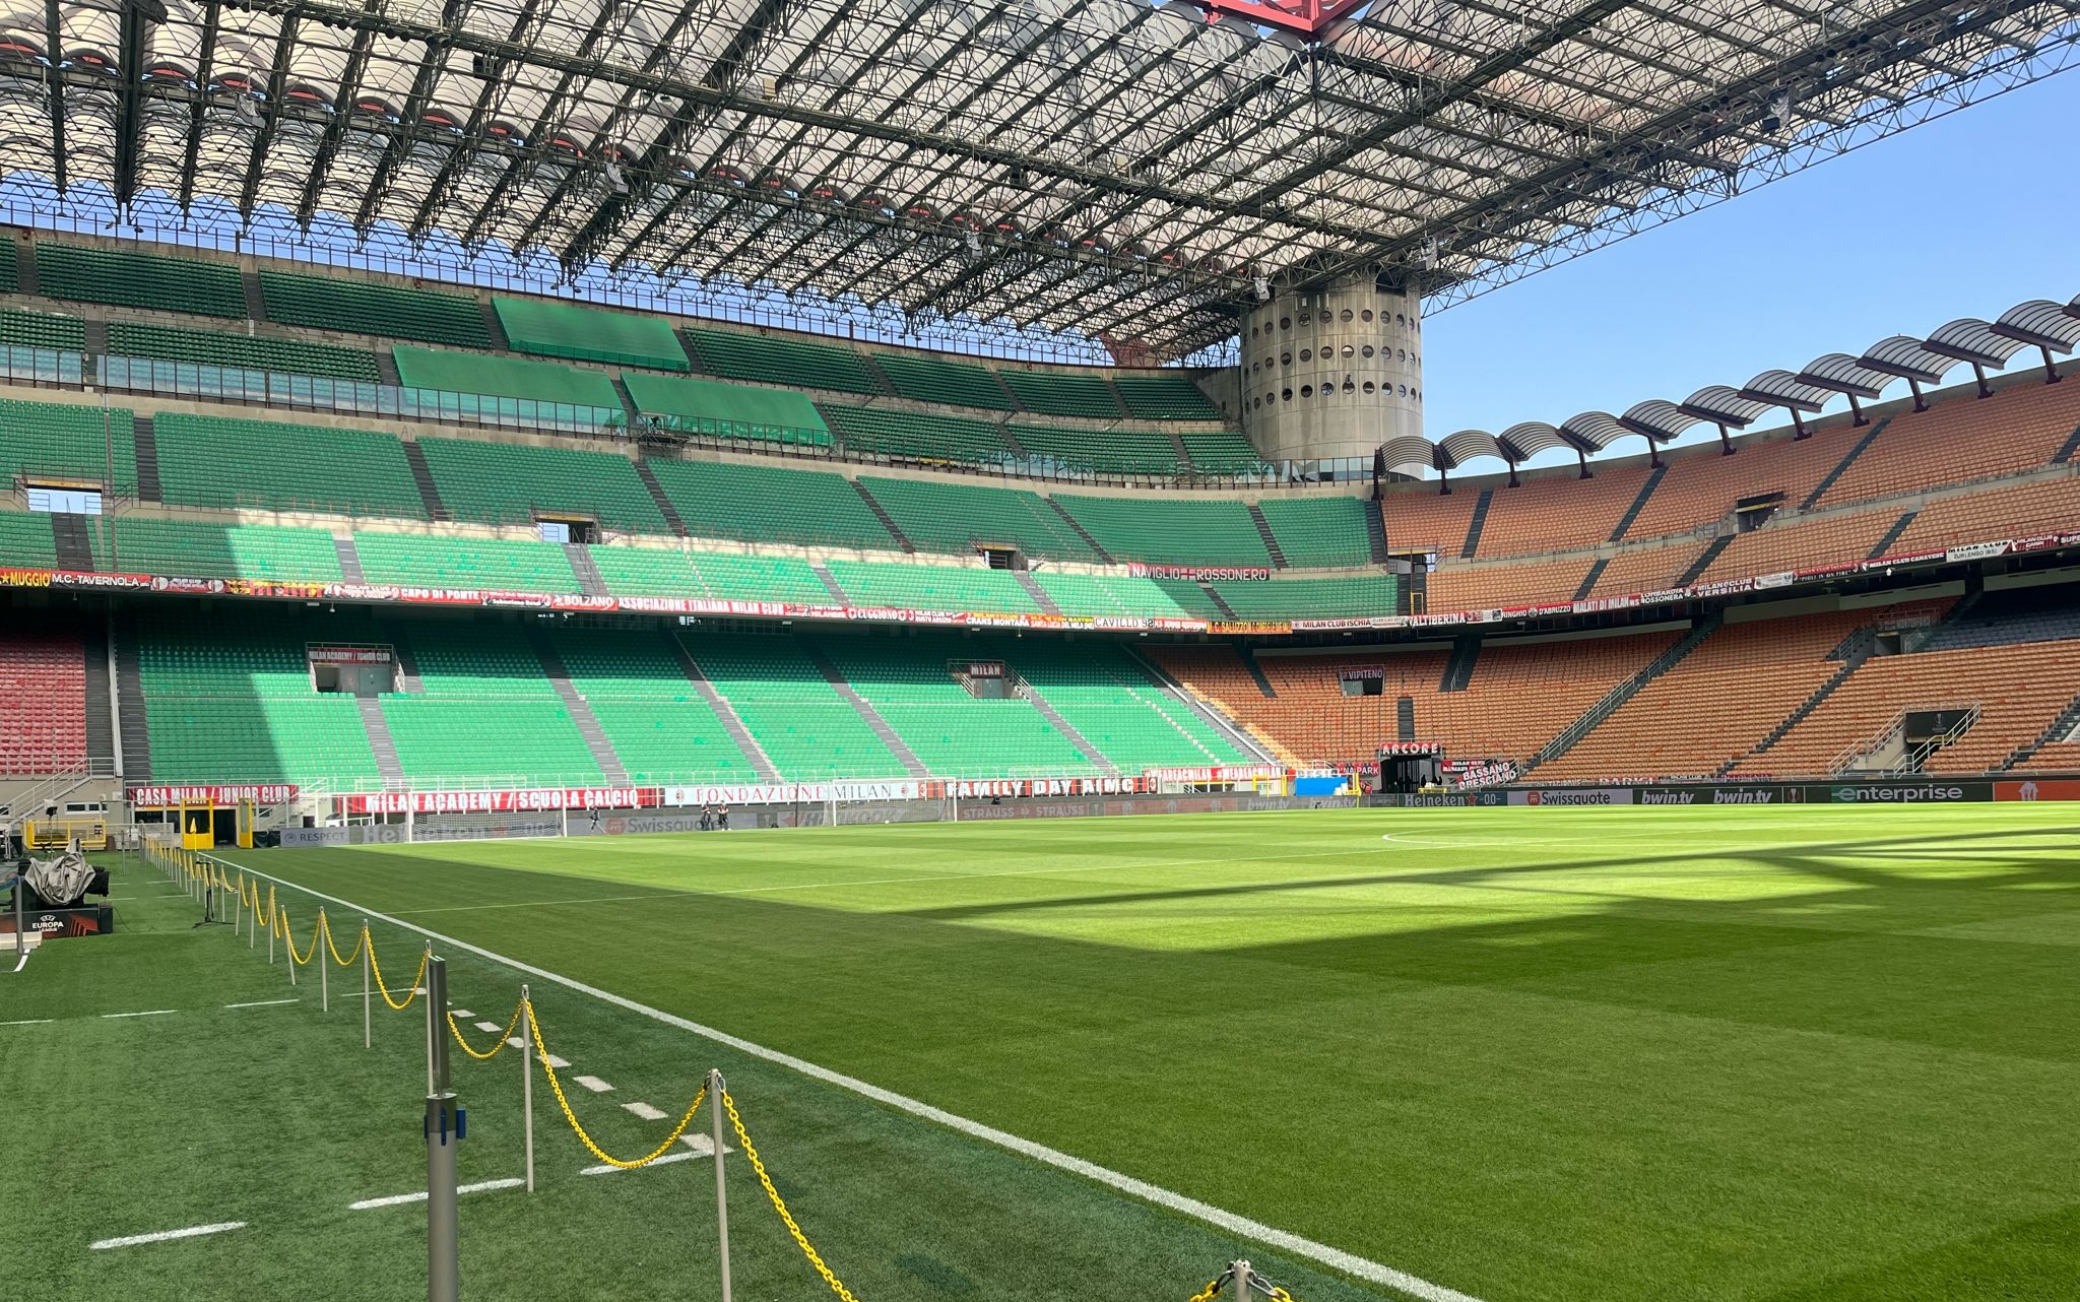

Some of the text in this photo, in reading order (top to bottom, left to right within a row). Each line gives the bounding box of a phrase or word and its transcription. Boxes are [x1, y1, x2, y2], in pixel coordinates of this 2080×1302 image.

[1870, 560, 1892, 568] MILAN
[1892, 558, 1910, 566] CLUB
[1132, 567, 1267, 581] NAVIGLIO ROSSONERO
[1697, 582, 1725, 592] MILAN
[1728, 577, 1752, 588] CLUB
[1697, 584, 1752, 598] VERSILIA
[401, 588, 428, 598] CAPO
[433, 589, 443, 598] DI
[446, 590, 479, 600] PONTE
[1641, 587, 1683, 597] LOMBARDIA
[1641, 593, 1684, 604] ROSSONERA
[564, 595, 613, 606] BOLZANO
[619, 597, 688, 612] ASSOCIAZIONE
[689, 599, 730, 613] ITALIANA
[731, 601, 759, 614] MILAN
[762, 603, 784, 616] CLUB
[1573, 600, 1598, 613] MALATI
[1599, 599, 1607, 611] DI
[1608, 596, 1629, 610] MILAN
[857, 608, 898, 619] CUGGIONO
[1409, 612, 1466, 628] VALTIBERINA
[993, 618, 1030, 627] MONTANA
[1302, 620, 1326, 628] MILAN
[1327, 619, 1346, 627] CLUB
[1347, 618, 1371, 627] ISCHIA
[376, 652, 391, 661] CLUB
[971, 665, 1000, 675] MILAN
[1348, 669, 1383, 680] VIPITENO
[1382, 743, 1439, 756] ARCORE
[1357, 766, 1379, 775] PARK
[1463, 762, 1510, 781] BASSANO
[696, 782, 892, 802] FONDAZIONE MILAN
[946, 777, 1134, 797] FAMILY DAY AIMC
[1833, 784, 1963, 803] enterprise
[136, 787, 168, 805] CASA
[171, 787, 207, 804] MILAN
[218, 786, 258, 804] JUNIOR
[261, 786, 290, 803] CLUB
[366, 793, 419, 812] MILAN
[425, 793, 502, 812] ACADEMY
[519, 790, 580, 809] SCUOLA
[584, 789, 639, 807] CALCIO
[1404, 794, 1466, 807] Heineken
[1542, 791, 1611, 805] Swissquote
[1641, 788, 1773, 804] bwin.tv bwin.tv
[963, 805, 1085, 819] STRAUSS STRAUSS
[300, 831, 346, 843] RESPECT
[32, 921, 64, 929] EUROPA
